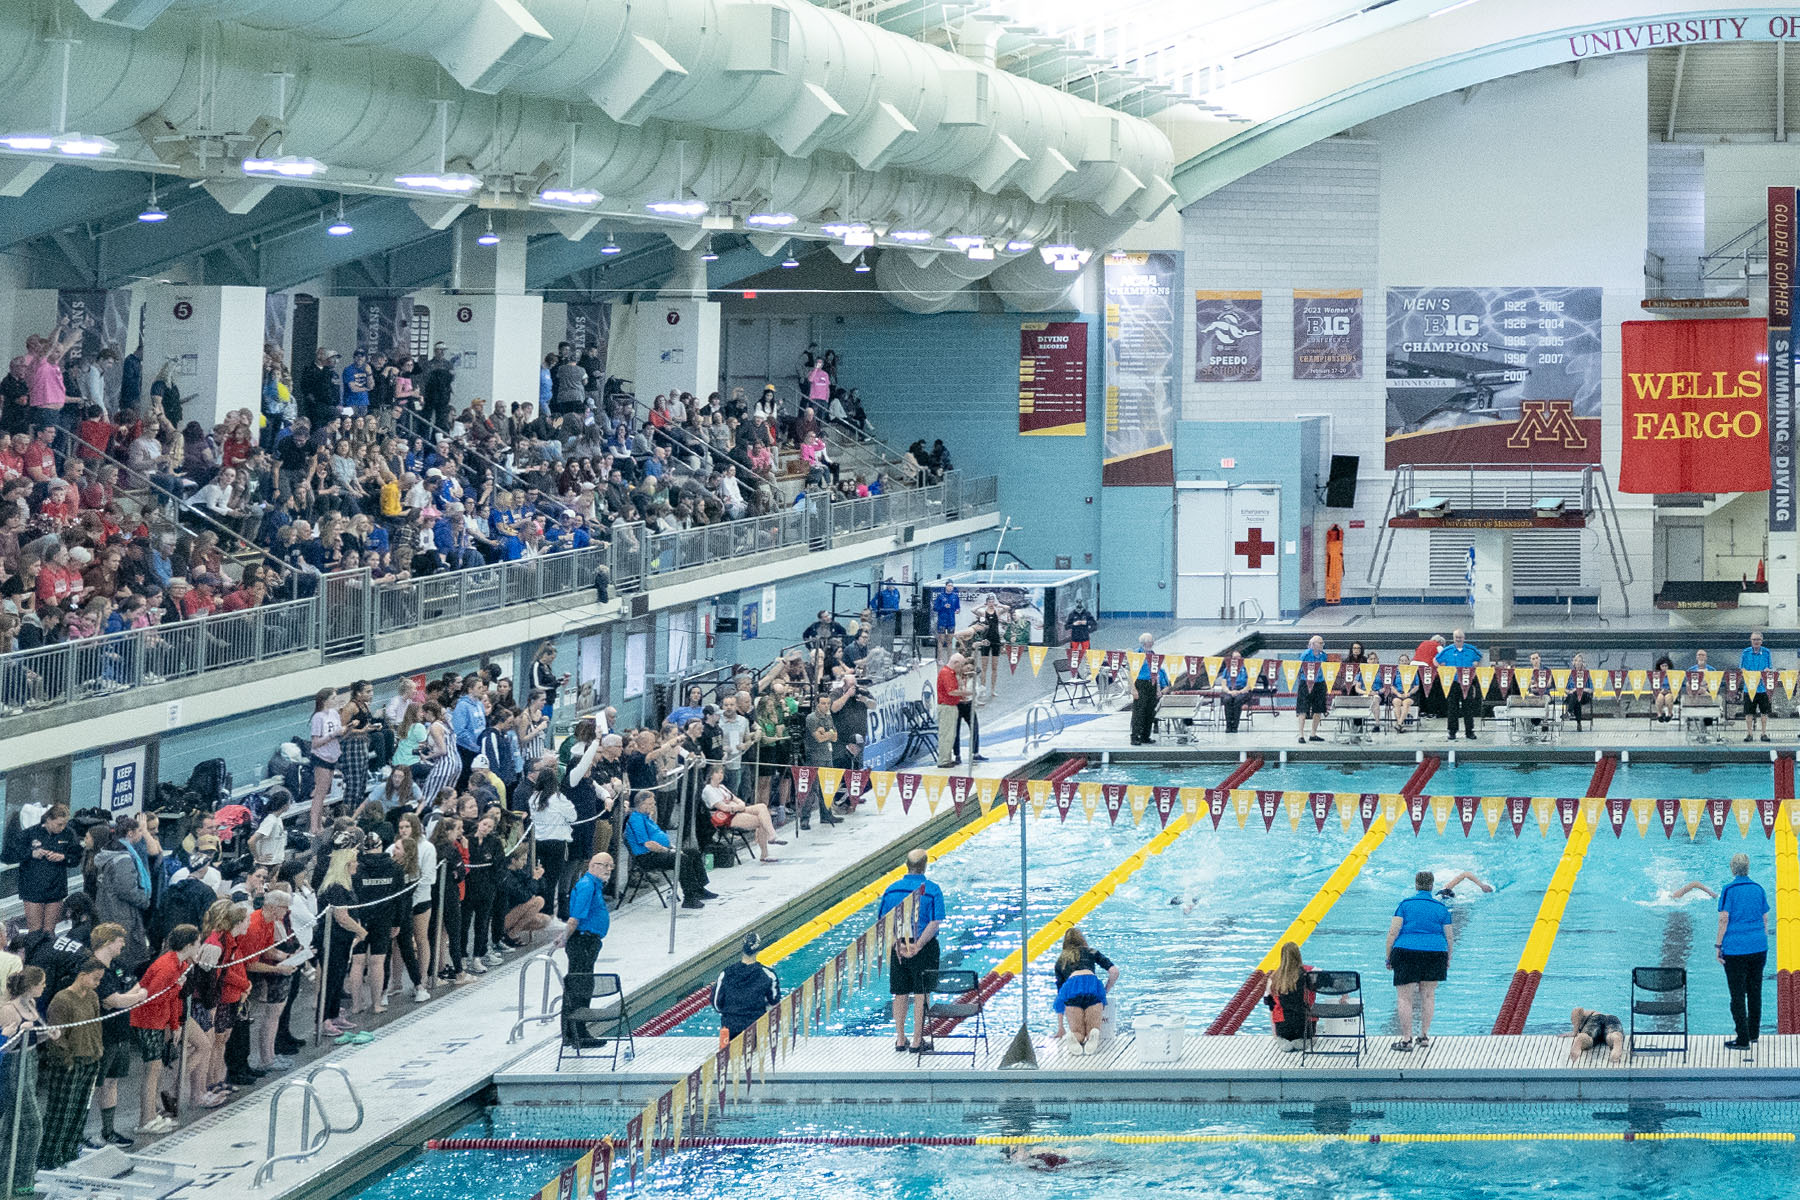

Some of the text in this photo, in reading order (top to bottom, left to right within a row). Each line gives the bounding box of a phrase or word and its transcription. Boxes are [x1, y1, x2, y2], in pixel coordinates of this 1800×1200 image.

[1568, 17, 1749, 58] UNIVERSITY
[1774, 204, 1788, 257] GOLDEN
[1775, 262, 1789, 316] GOPHER
[1403, 298, 1451, 311] MEN'S
[1539, 301, 1565, 312] 2002
[178, 305, 187, 317] 5
[461, 309, 468, 320] 6
[670, 313, 677, 323] 7
[1539, 318, 1565, 329] 2004
[1037, 335, 1069, 343] DIVING
[1539, 336, 1565, 346] 2005
[1402, 342, 1489, 352] CHAMPIONS
[1209, 356, 1248, 365] SPEEDO
[1299, 355, 1357, 363] CHAMPIONSHIPS
[1539, 353, 1565, 363] 2007
[1201, 366, 1257, 376] SECTIONALS
[1627, 370, 1763, 400] WELLS
[1507, 400, 1587, 449] M
[1632, 410, 1762, 440] FARGO
[1441, 519, 1482, 528] UNIVERSITY
[1493, 519, 1533, 528] MINNESOTA
[117, 766, 133, 779] KEEP
[114, 780, 132, 794] AREA
[113, 792, 133, 807] CLEAR
